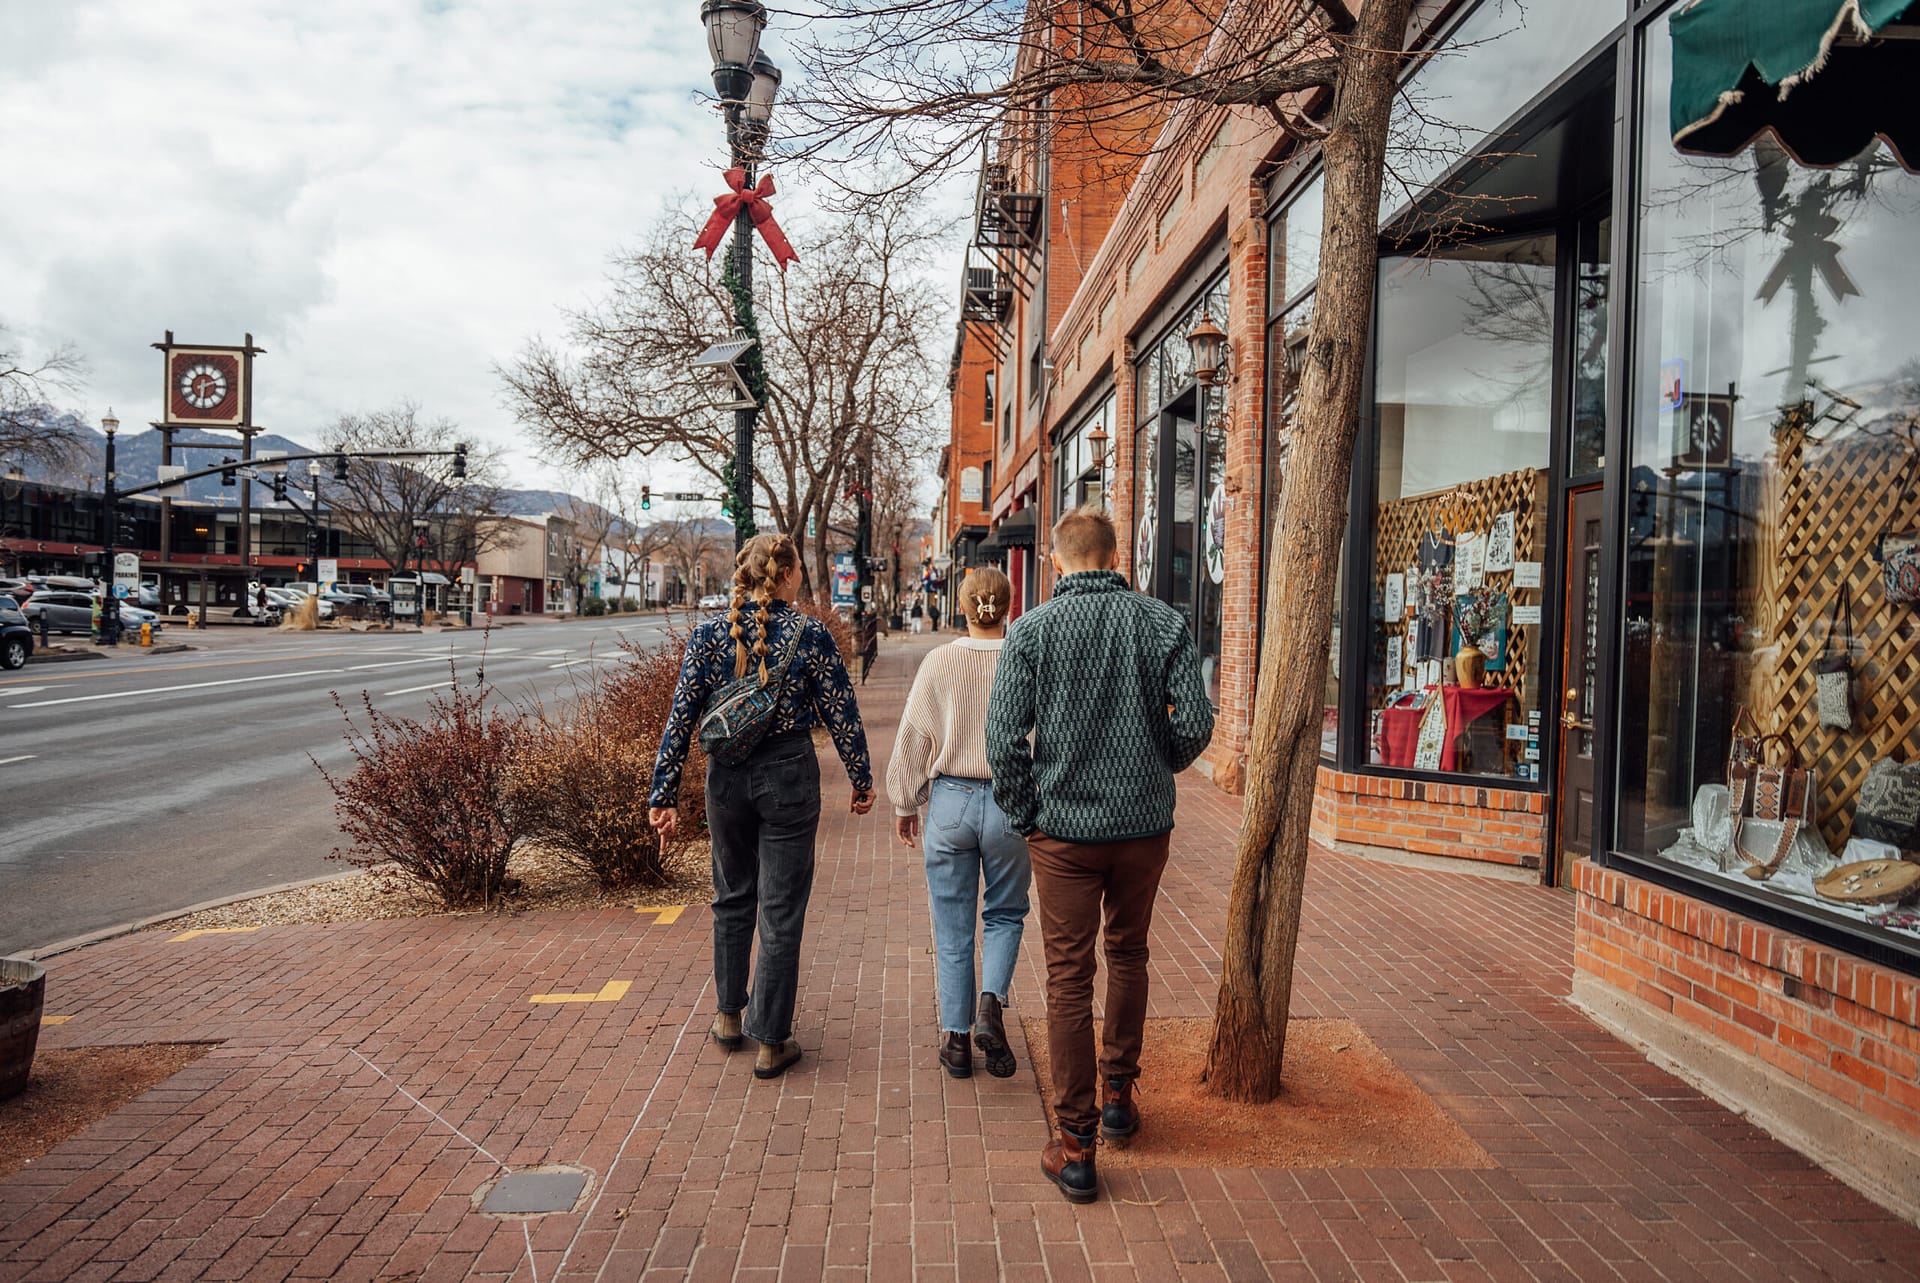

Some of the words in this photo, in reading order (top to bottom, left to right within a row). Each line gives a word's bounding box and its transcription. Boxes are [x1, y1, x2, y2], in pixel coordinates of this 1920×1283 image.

[1439, 492, 1454, 502] OUT
[1456, 491, 1477, 501] WEST
[116, 585, 127, 597] P
